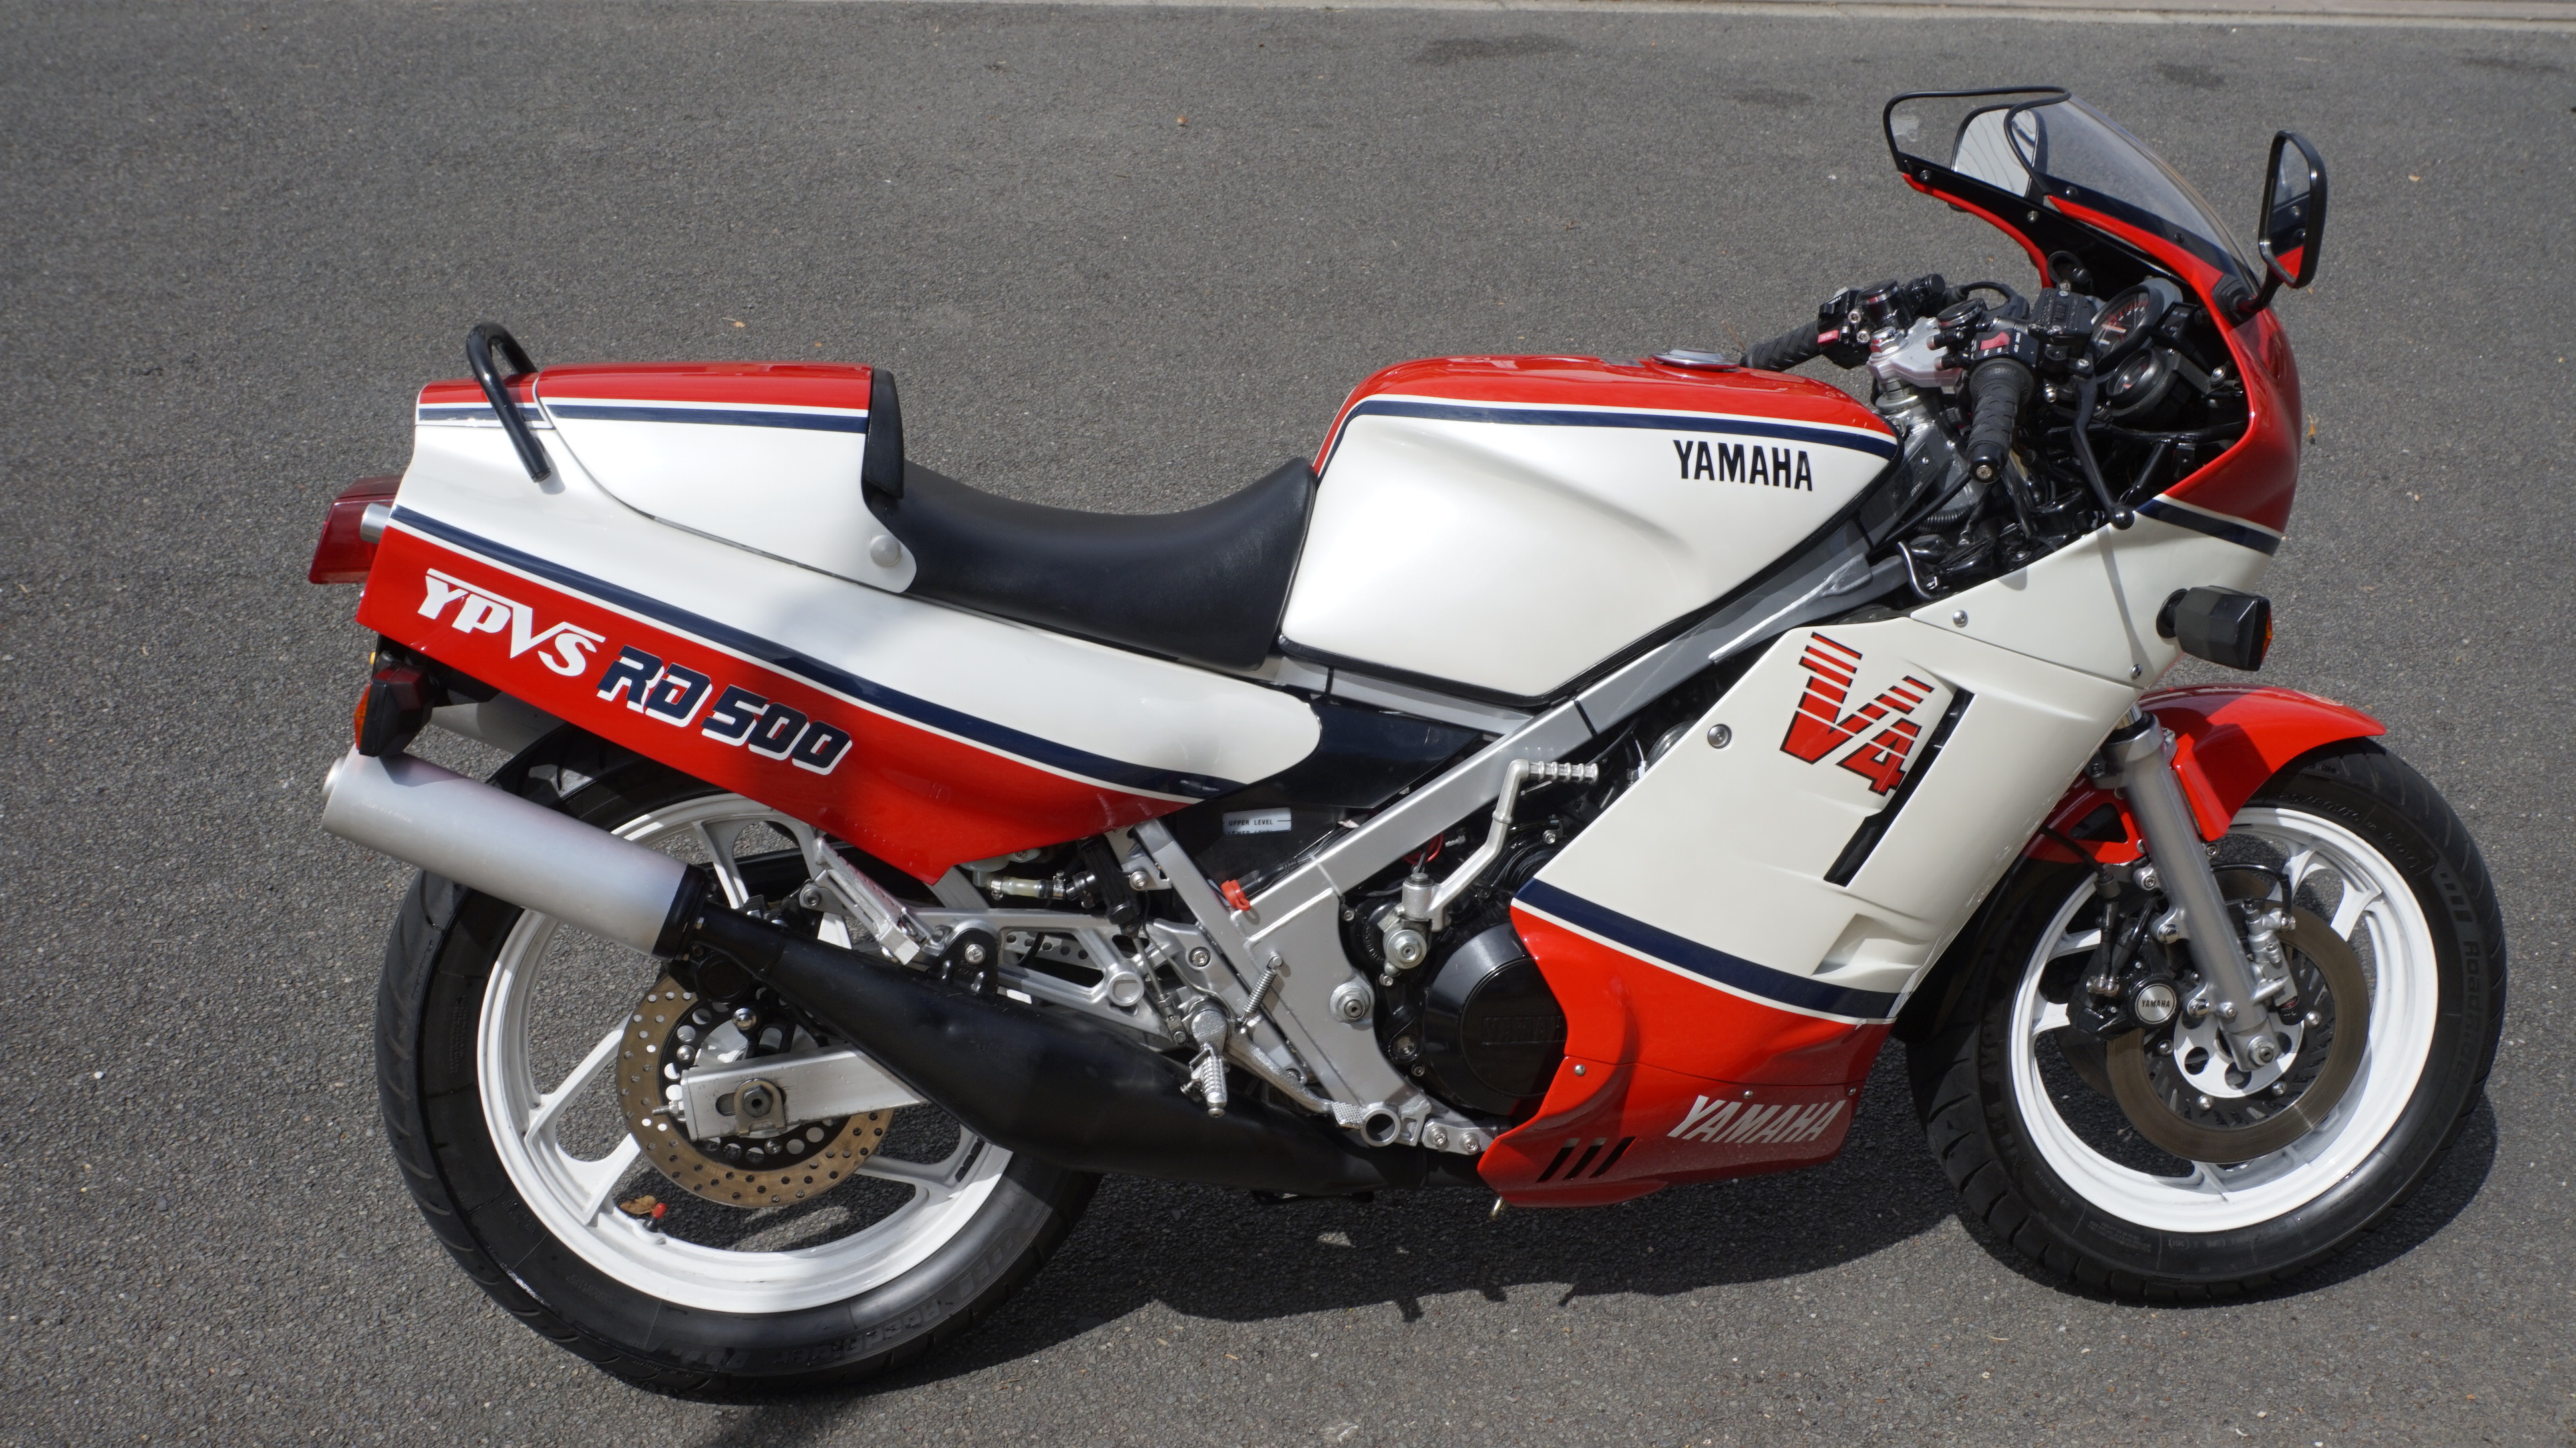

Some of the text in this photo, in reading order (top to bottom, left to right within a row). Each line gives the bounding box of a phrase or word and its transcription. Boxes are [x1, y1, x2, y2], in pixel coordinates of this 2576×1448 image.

[1673, 440, 1813, 492] YAMAHA
[416, 568, 853, 775] YPVS RD 500
[1779, 631, 1935, 797] V4
[2142, 999, 2170, 1008] YAMAHA
[1485, 1017, 1566, 1042] YAMAH
[1667, 1095, 1846, 1144] YAMAHA
